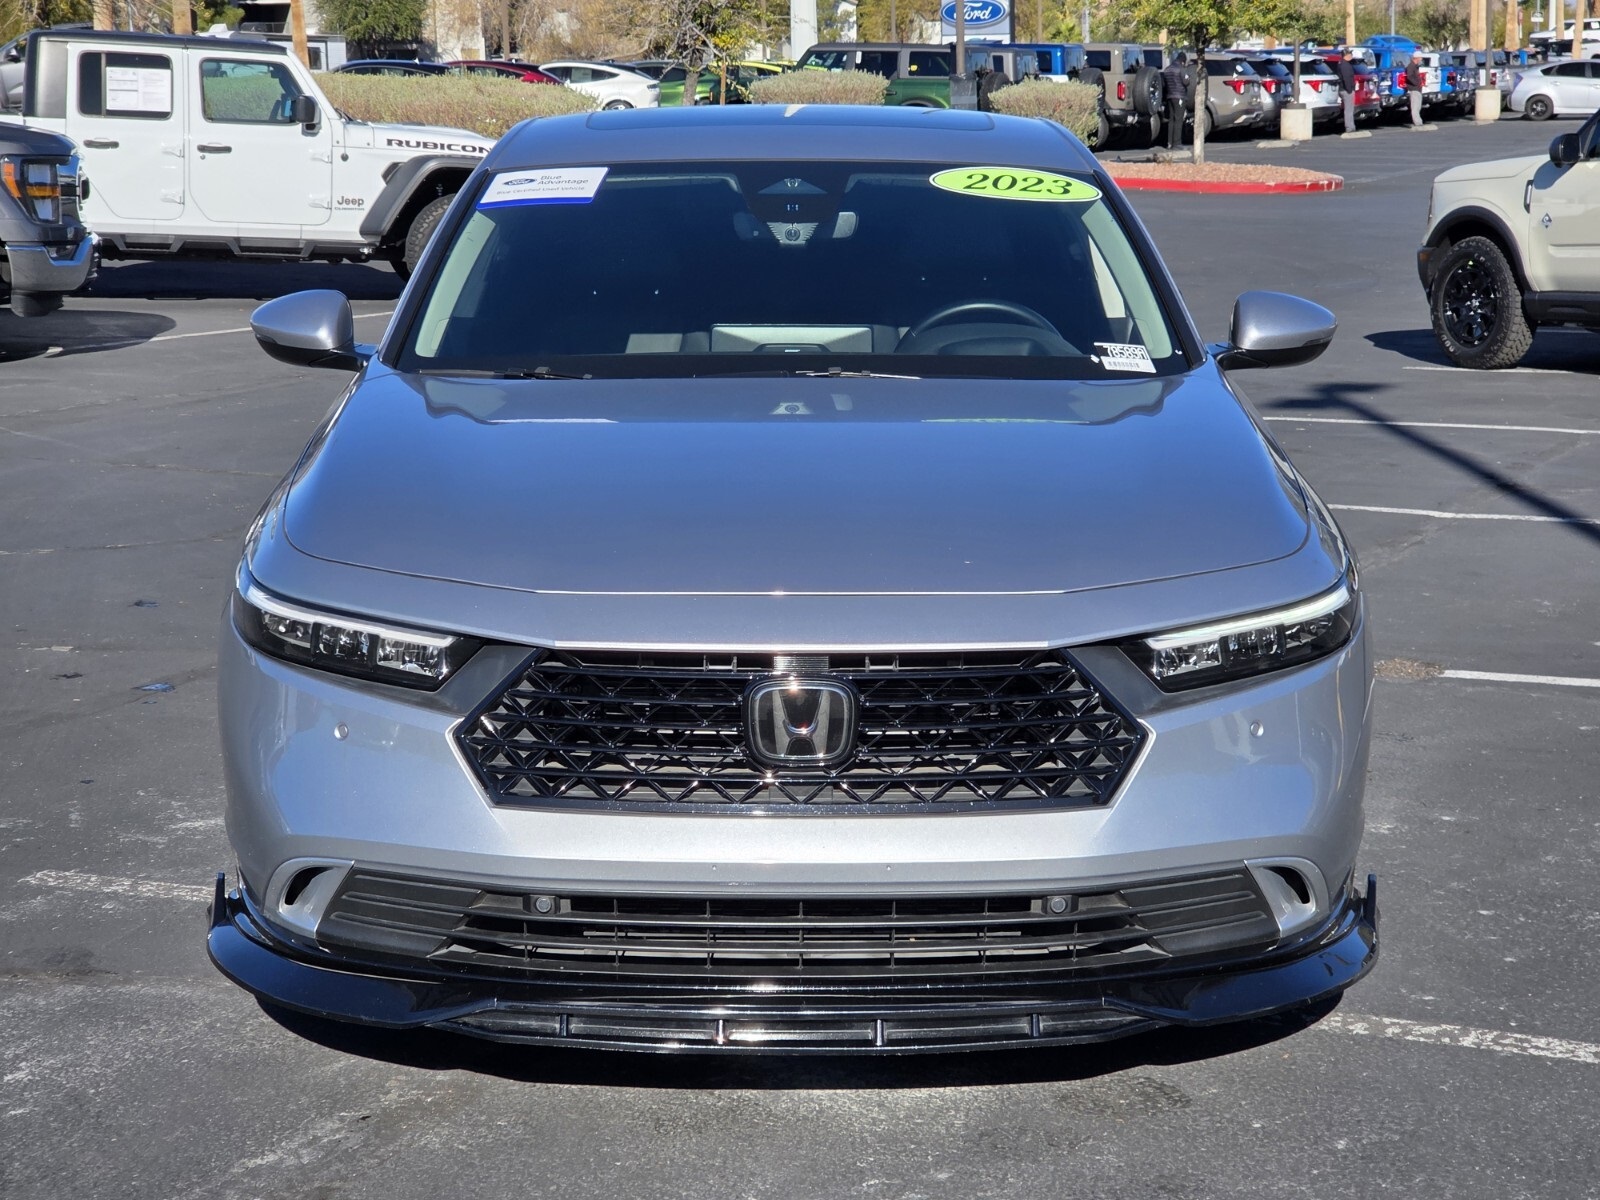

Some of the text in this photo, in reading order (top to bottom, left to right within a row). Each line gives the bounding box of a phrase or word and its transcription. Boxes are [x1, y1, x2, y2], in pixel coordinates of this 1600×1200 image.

[386, 138, 492, 154] RUBICON
[963, 173, 1073, 195] 2023
[337, 196, 364, 207] Jeep
